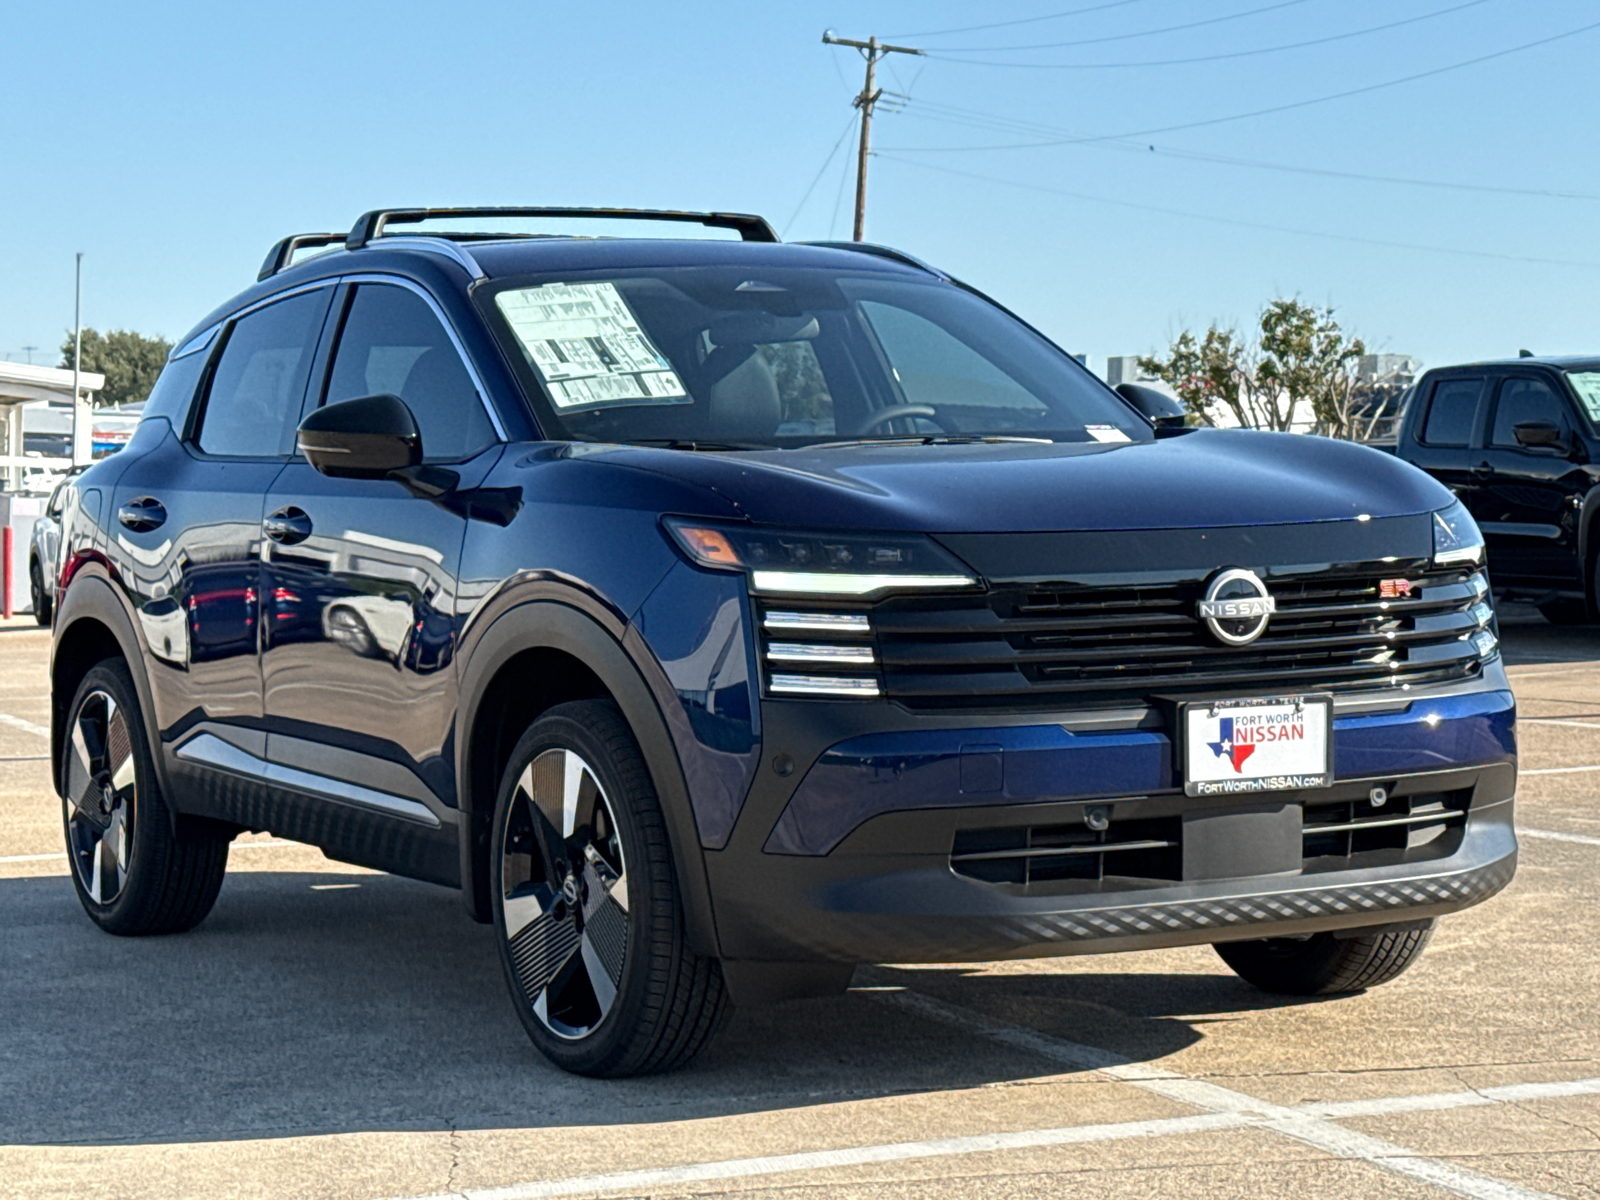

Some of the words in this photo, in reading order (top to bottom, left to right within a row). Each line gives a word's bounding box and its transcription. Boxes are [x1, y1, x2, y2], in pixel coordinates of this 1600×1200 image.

[1380, 579, 1411, 597] SR
[1201, 599, 1276, 617] NISSAN
[1235, 716, 1262, 725] FORT
[1265, 713, 1303, 723] WORTH
[1236, 724, 1303, 742] NISSAN
